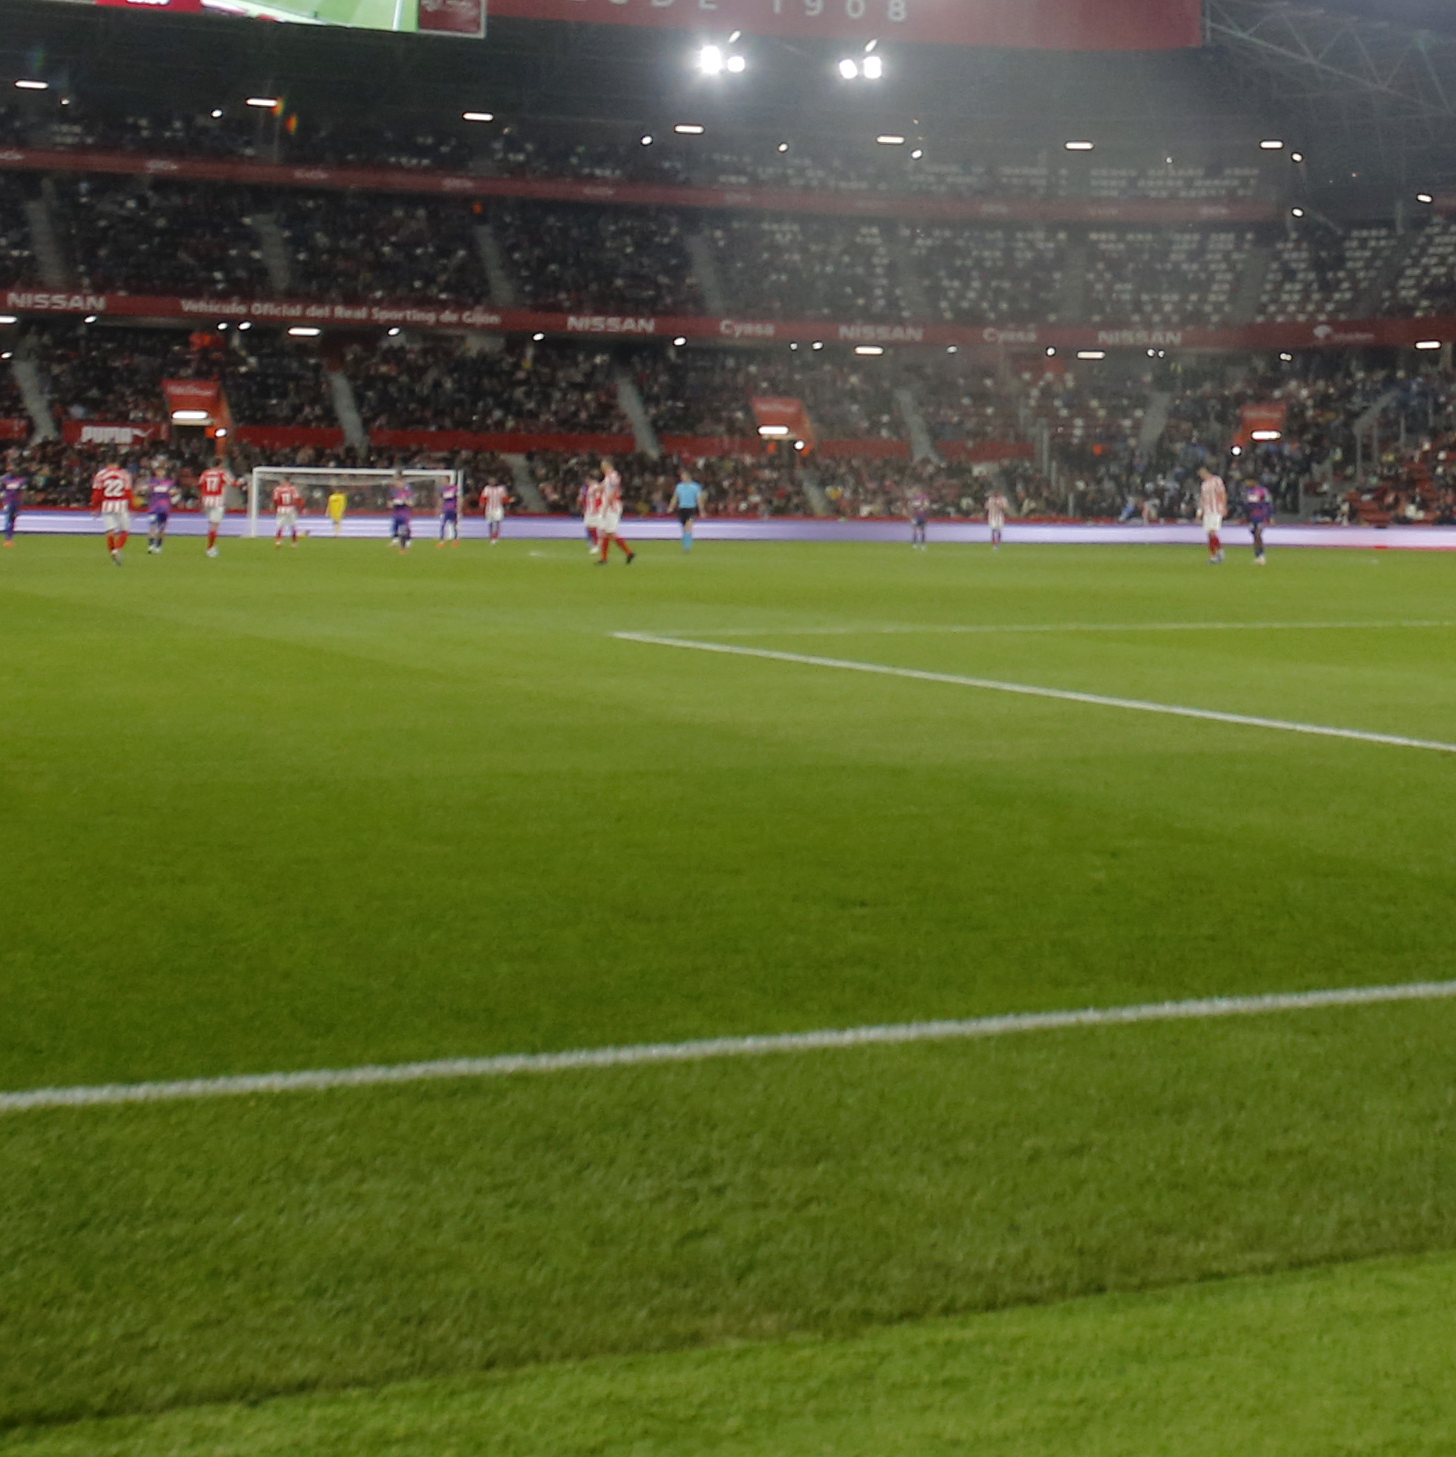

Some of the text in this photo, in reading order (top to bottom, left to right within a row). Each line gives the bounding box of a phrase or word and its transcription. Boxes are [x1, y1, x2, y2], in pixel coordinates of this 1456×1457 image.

[6, 292, 107, 311] NISSAN
[334, 304, 369, 319] Real
[371, 307, 436, 325] Sporting
[567, 316, 656, 334] NISSAN
[719, 319, 775, 338] Cyasa
[838, 324, 924, 342] NISSAN
[1098, 329, 1183, 345] NISSAN
[103, 479, 125, 497] 22
